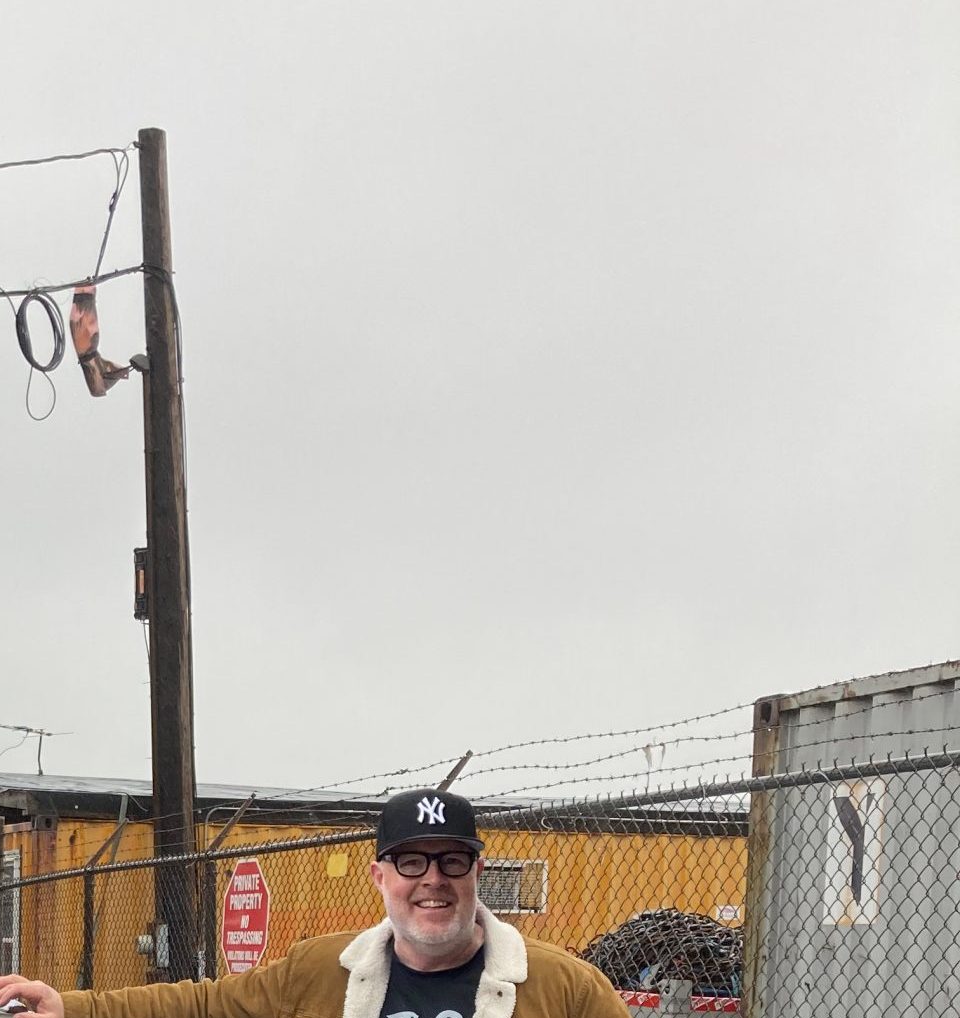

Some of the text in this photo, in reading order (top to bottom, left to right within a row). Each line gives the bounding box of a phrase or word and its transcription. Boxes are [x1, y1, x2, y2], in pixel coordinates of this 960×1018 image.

[417, 796, 446, 825] NY
[233, 874, 260, 892] PRIVATE
[229, 893, 263, 911] PROPERTY
[240, 914, 250, 929] NO
[226, 931, 264, 945] TRESPASSING
